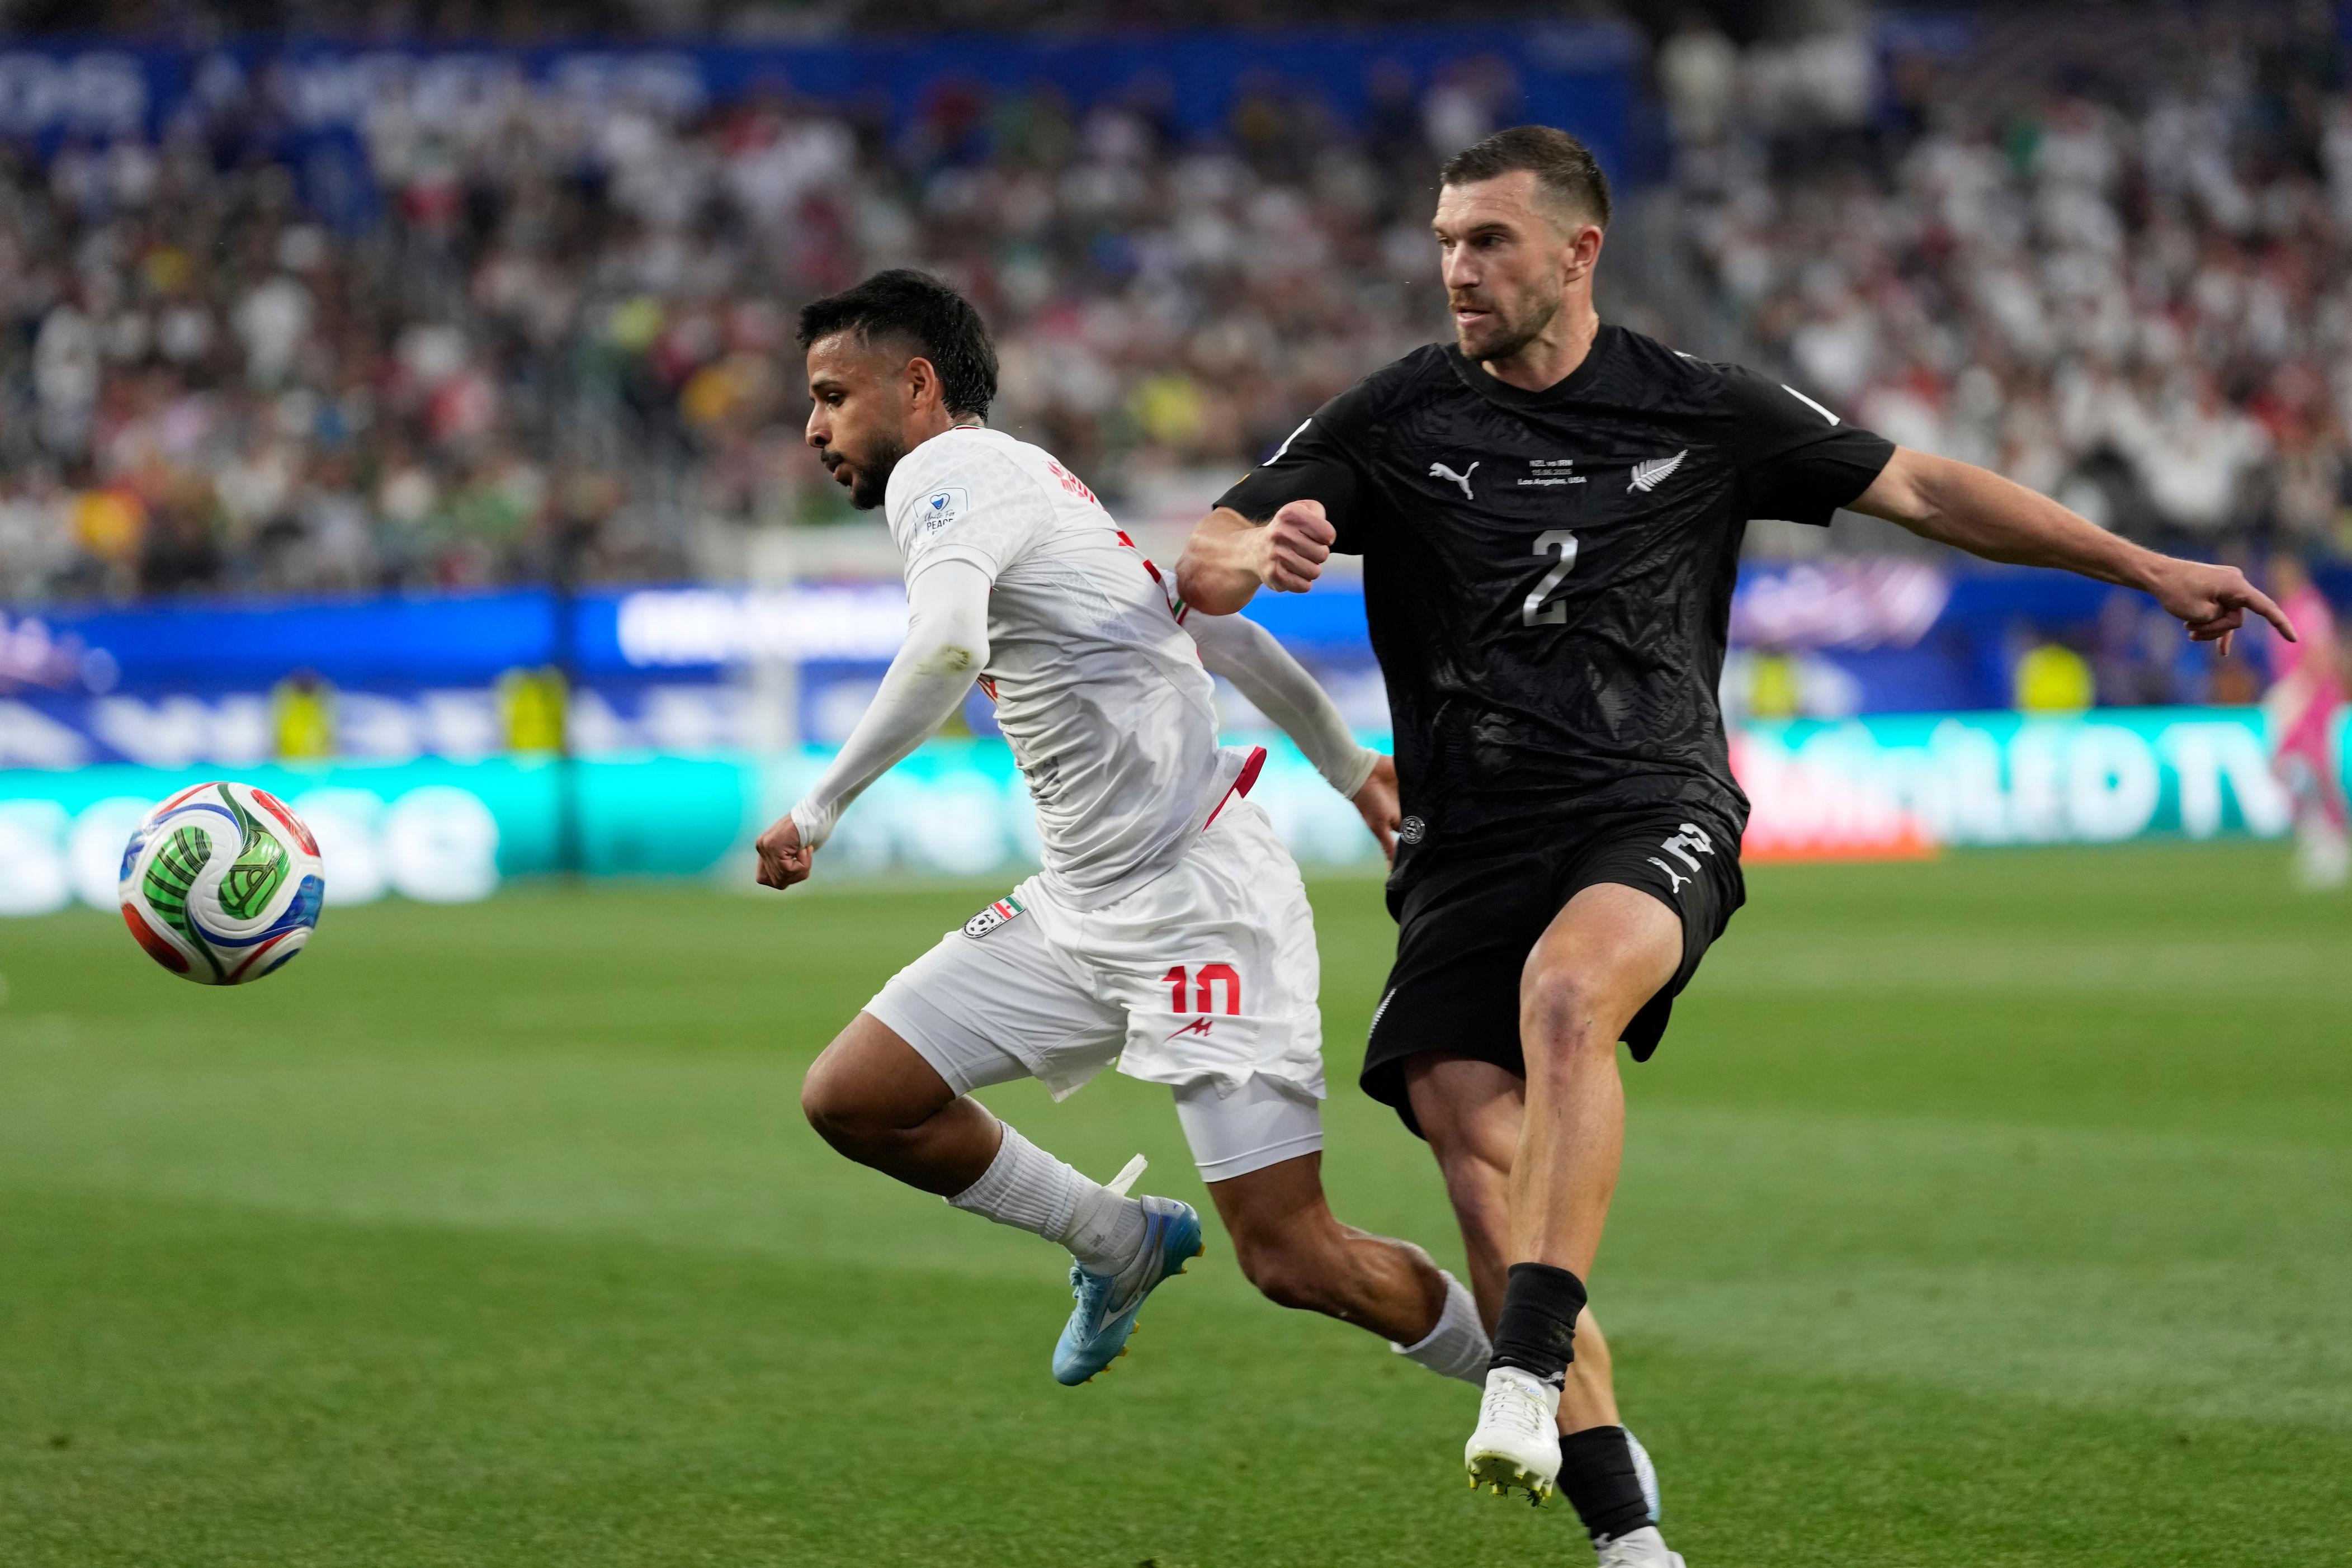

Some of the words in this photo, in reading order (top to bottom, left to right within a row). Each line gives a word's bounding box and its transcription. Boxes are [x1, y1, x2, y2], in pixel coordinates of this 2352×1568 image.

[1523, 530, 1578, 627] 2
[1660, 823, 1715, 872] 2
[1161, 965, 1240, 1015] 10
